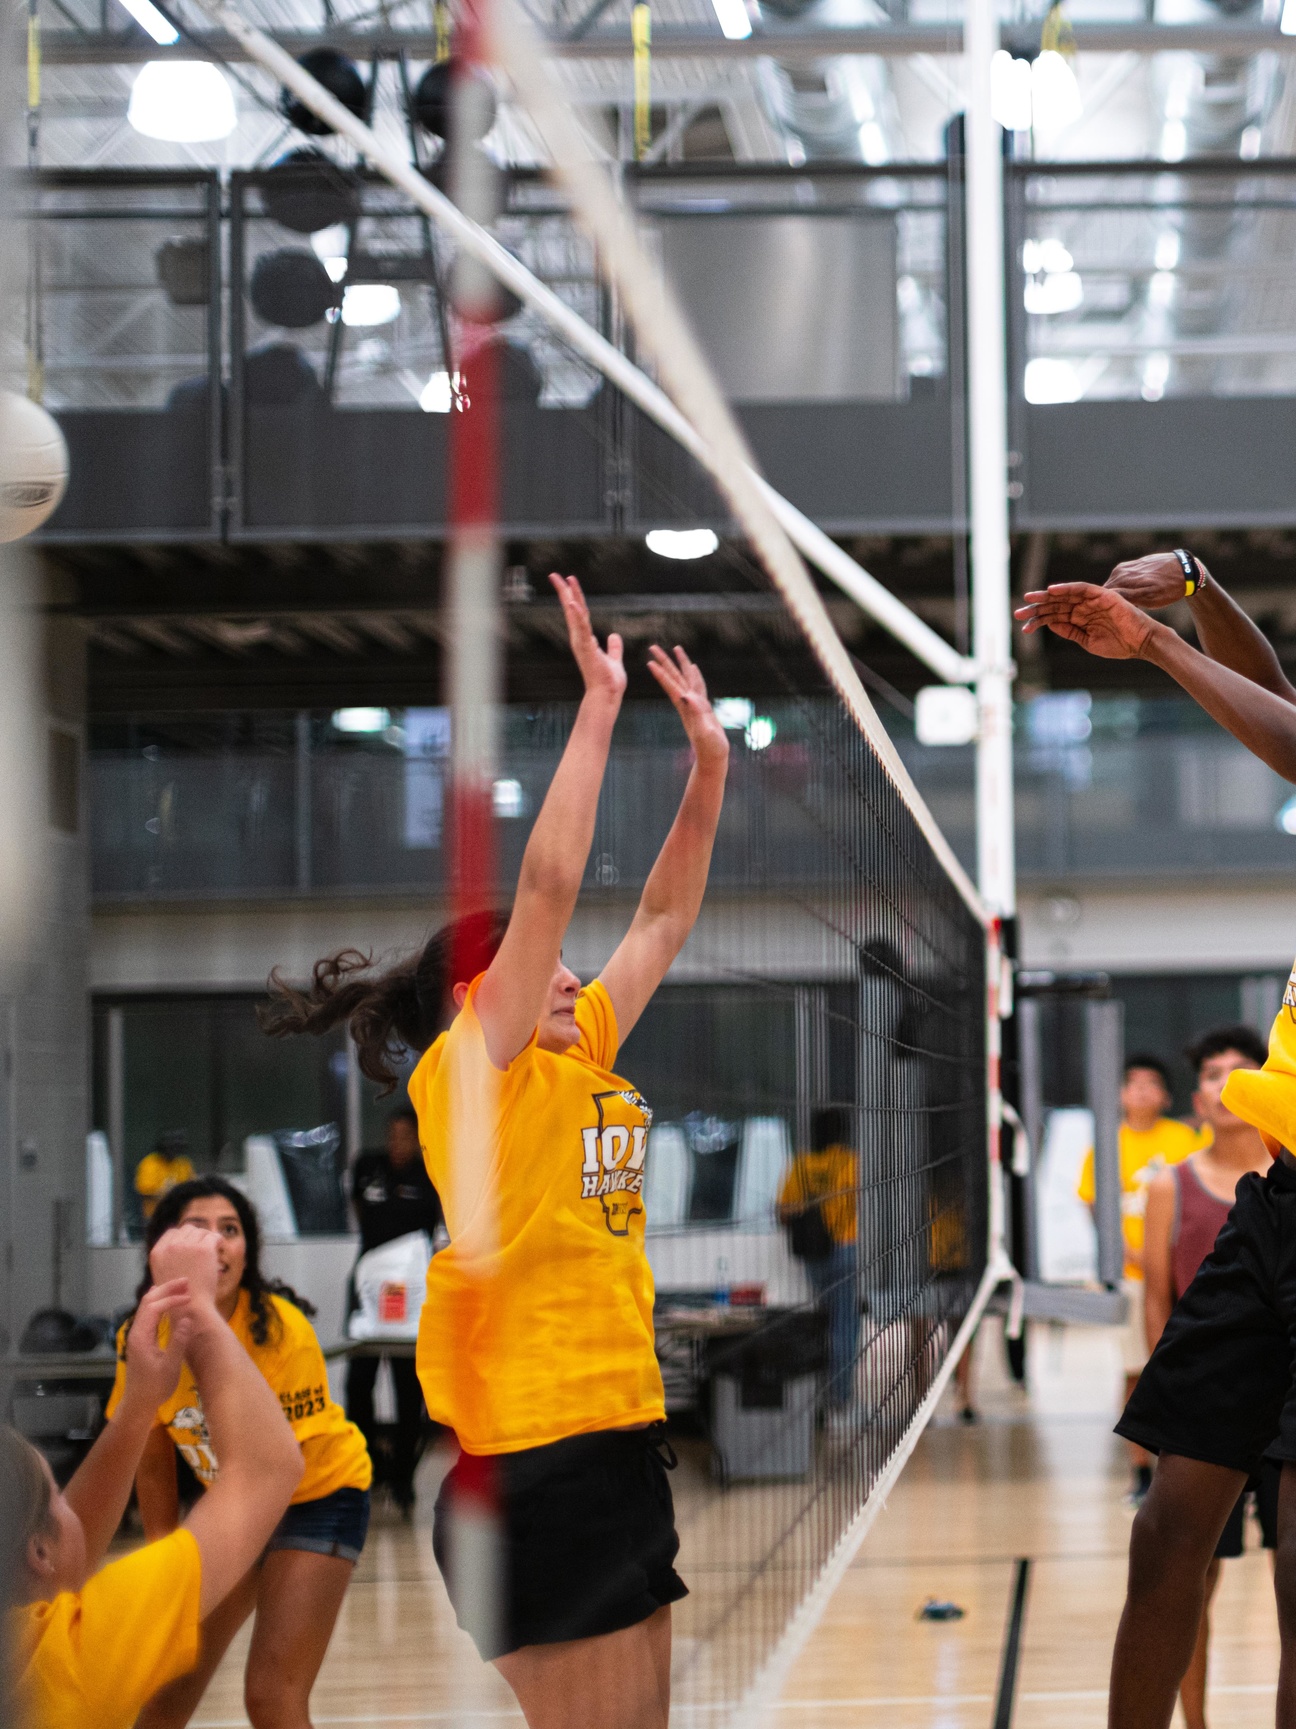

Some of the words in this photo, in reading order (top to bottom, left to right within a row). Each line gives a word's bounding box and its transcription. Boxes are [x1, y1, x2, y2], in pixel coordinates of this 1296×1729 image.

[581, 1125, 648, 1173] IOW
[581, 1170, 643, 1199] HAWKE
[282, 1396, 325, 1421] 2023
